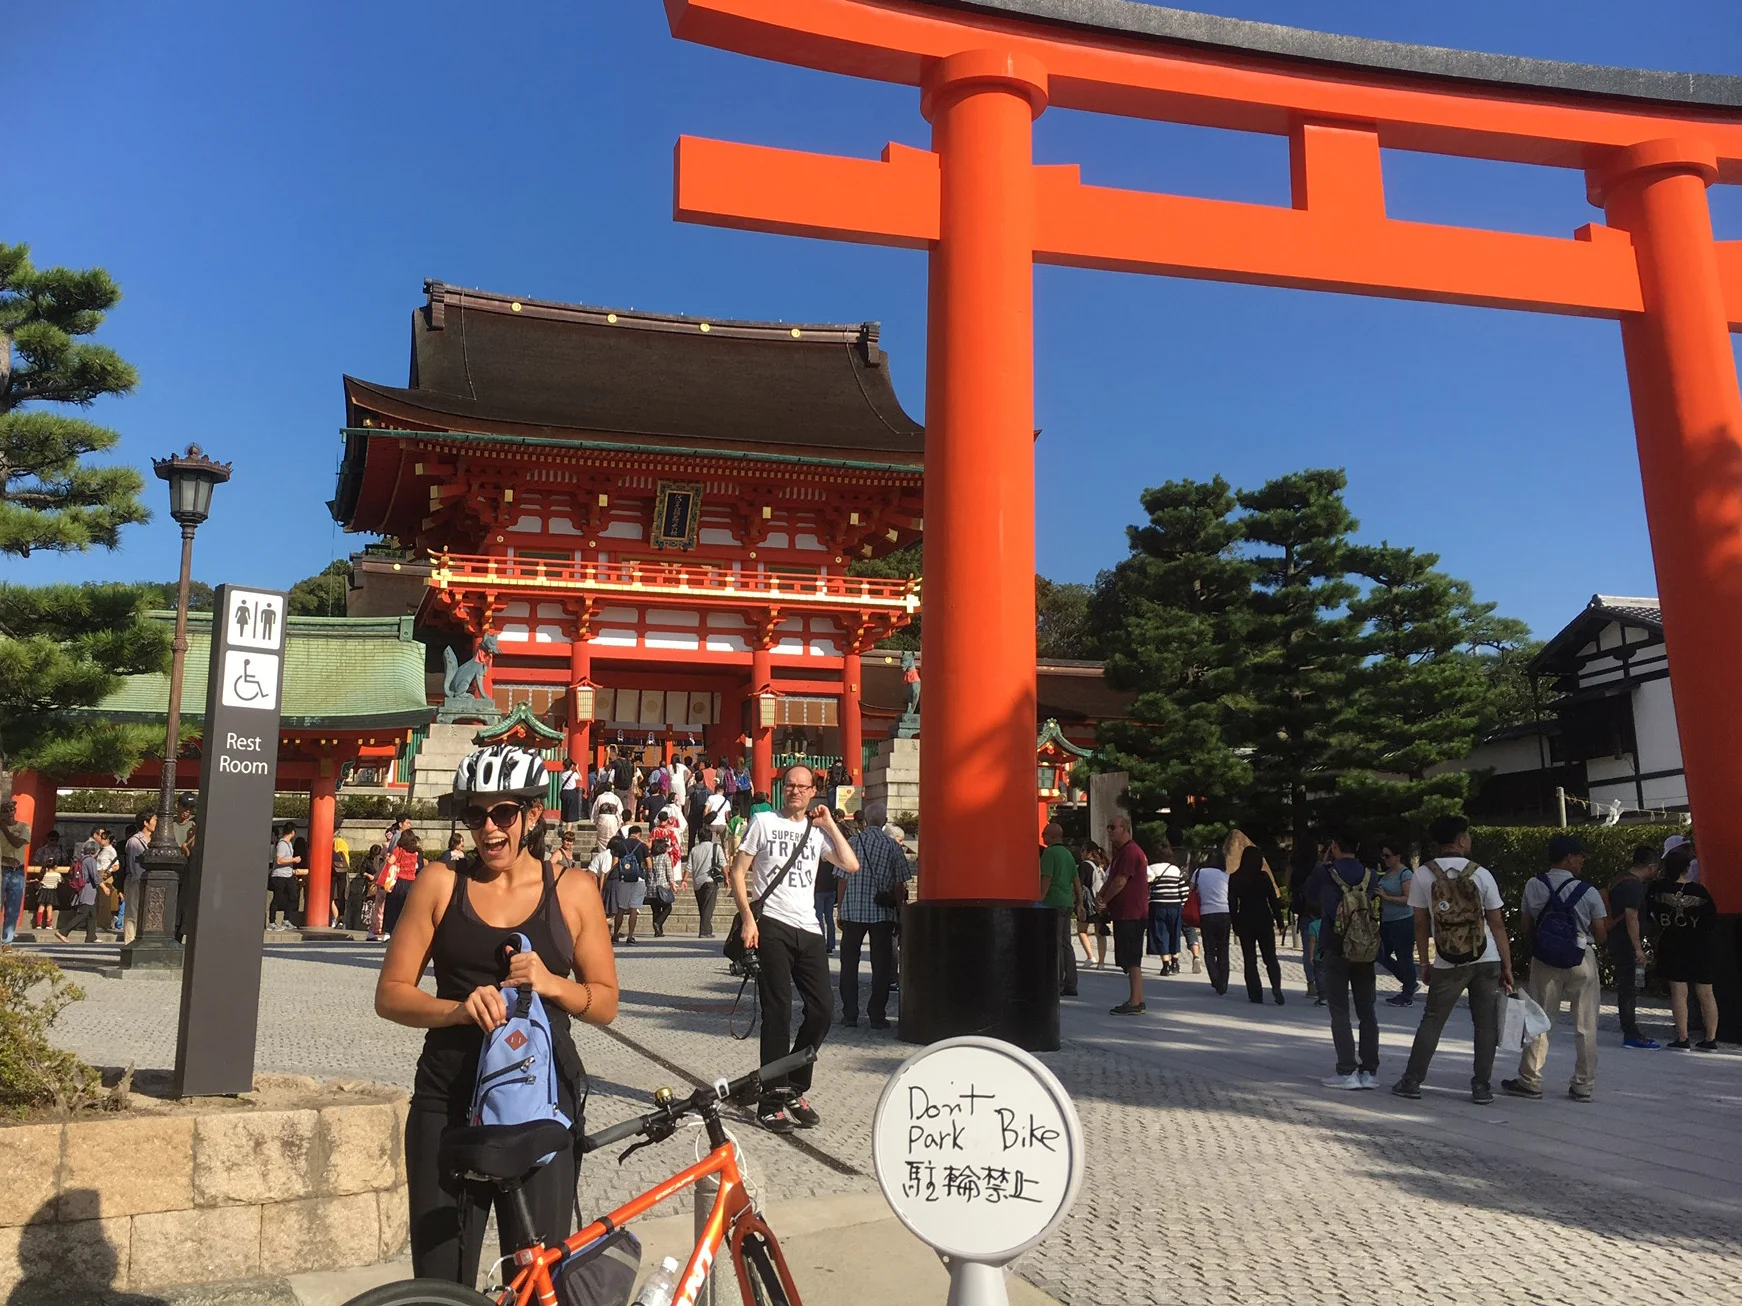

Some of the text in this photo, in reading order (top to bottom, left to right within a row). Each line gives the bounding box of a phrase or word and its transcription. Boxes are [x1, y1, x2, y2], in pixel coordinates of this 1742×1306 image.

[226, 732, 262, 751] Rest
[219, 755, 268, 775] Room
[766, 863, 813, 888] FELD
[908, 1107, 1060, 1155] Park Bike
[902, 1160, 1044, 1203] 駐輪禁止
